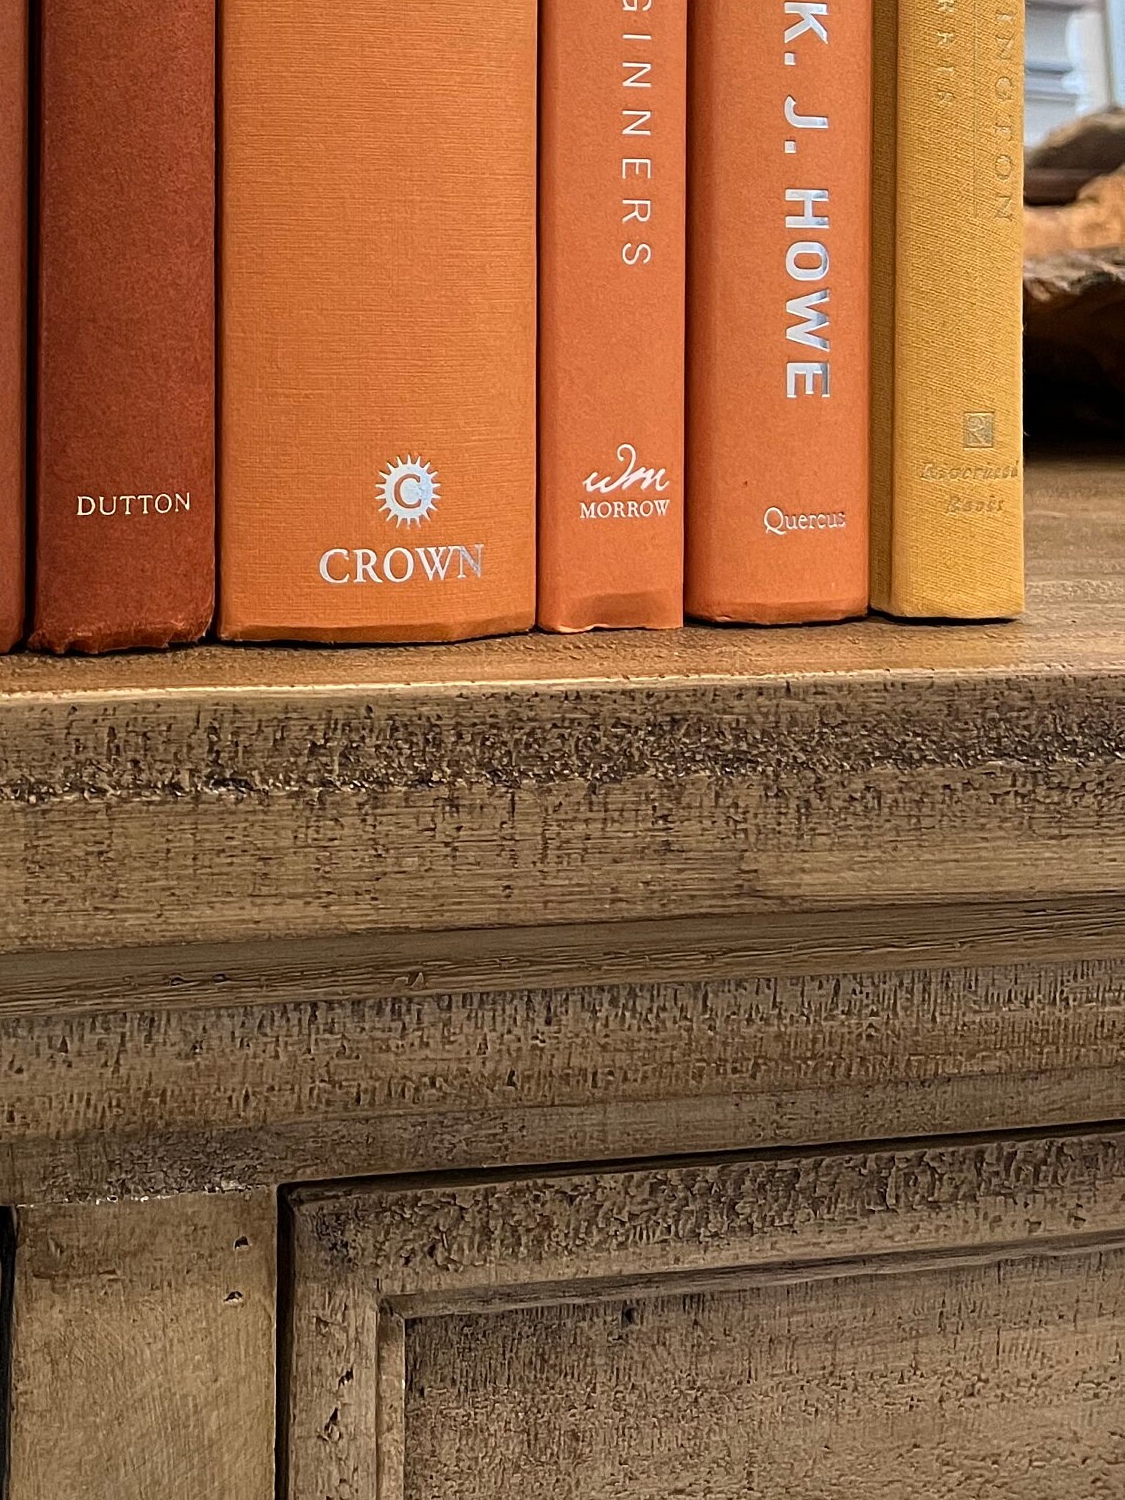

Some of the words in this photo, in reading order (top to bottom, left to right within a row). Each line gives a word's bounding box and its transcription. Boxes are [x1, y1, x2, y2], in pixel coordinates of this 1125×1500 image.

[783, 1, 829, 66] K.
[783, 95, 829, 154] J.
[783, 188, 831, 399] HOWE
[76, 492, 192, 517] DUTTON
[580, 499, 670, 519] MORROW
[764, 505, 847, 535] Quercus
[319, 542, 484, 585] CROWN
